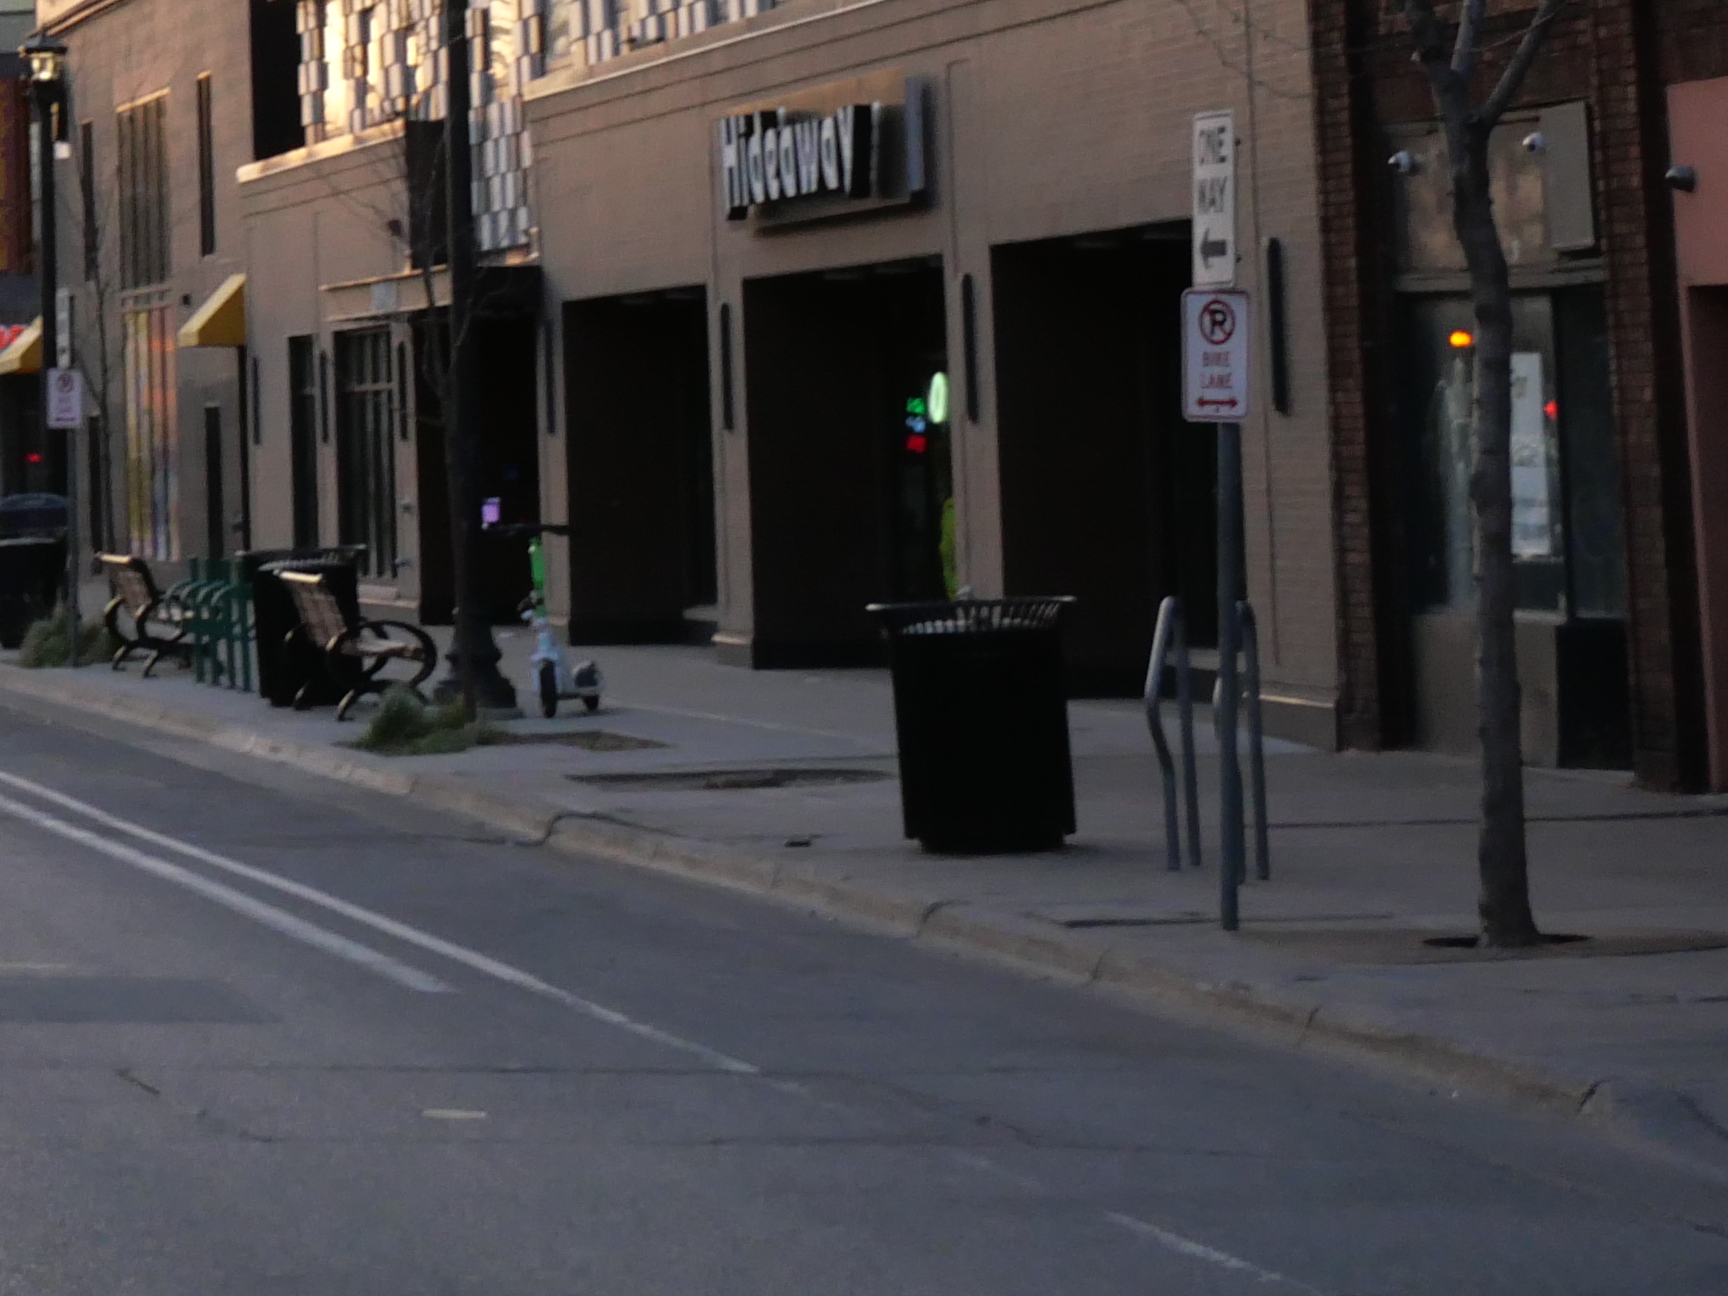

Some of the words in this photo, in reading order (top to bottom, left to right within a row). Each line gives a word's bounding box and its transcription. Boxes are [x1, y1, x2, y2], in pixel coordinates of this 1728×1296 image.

[719, 105, 855, 213] Hideaway
[1197, 125, 1227, 165] ONE
[1197, 177, 1228, 214] WAY
[1200, 371, 1233, 390] LANE
